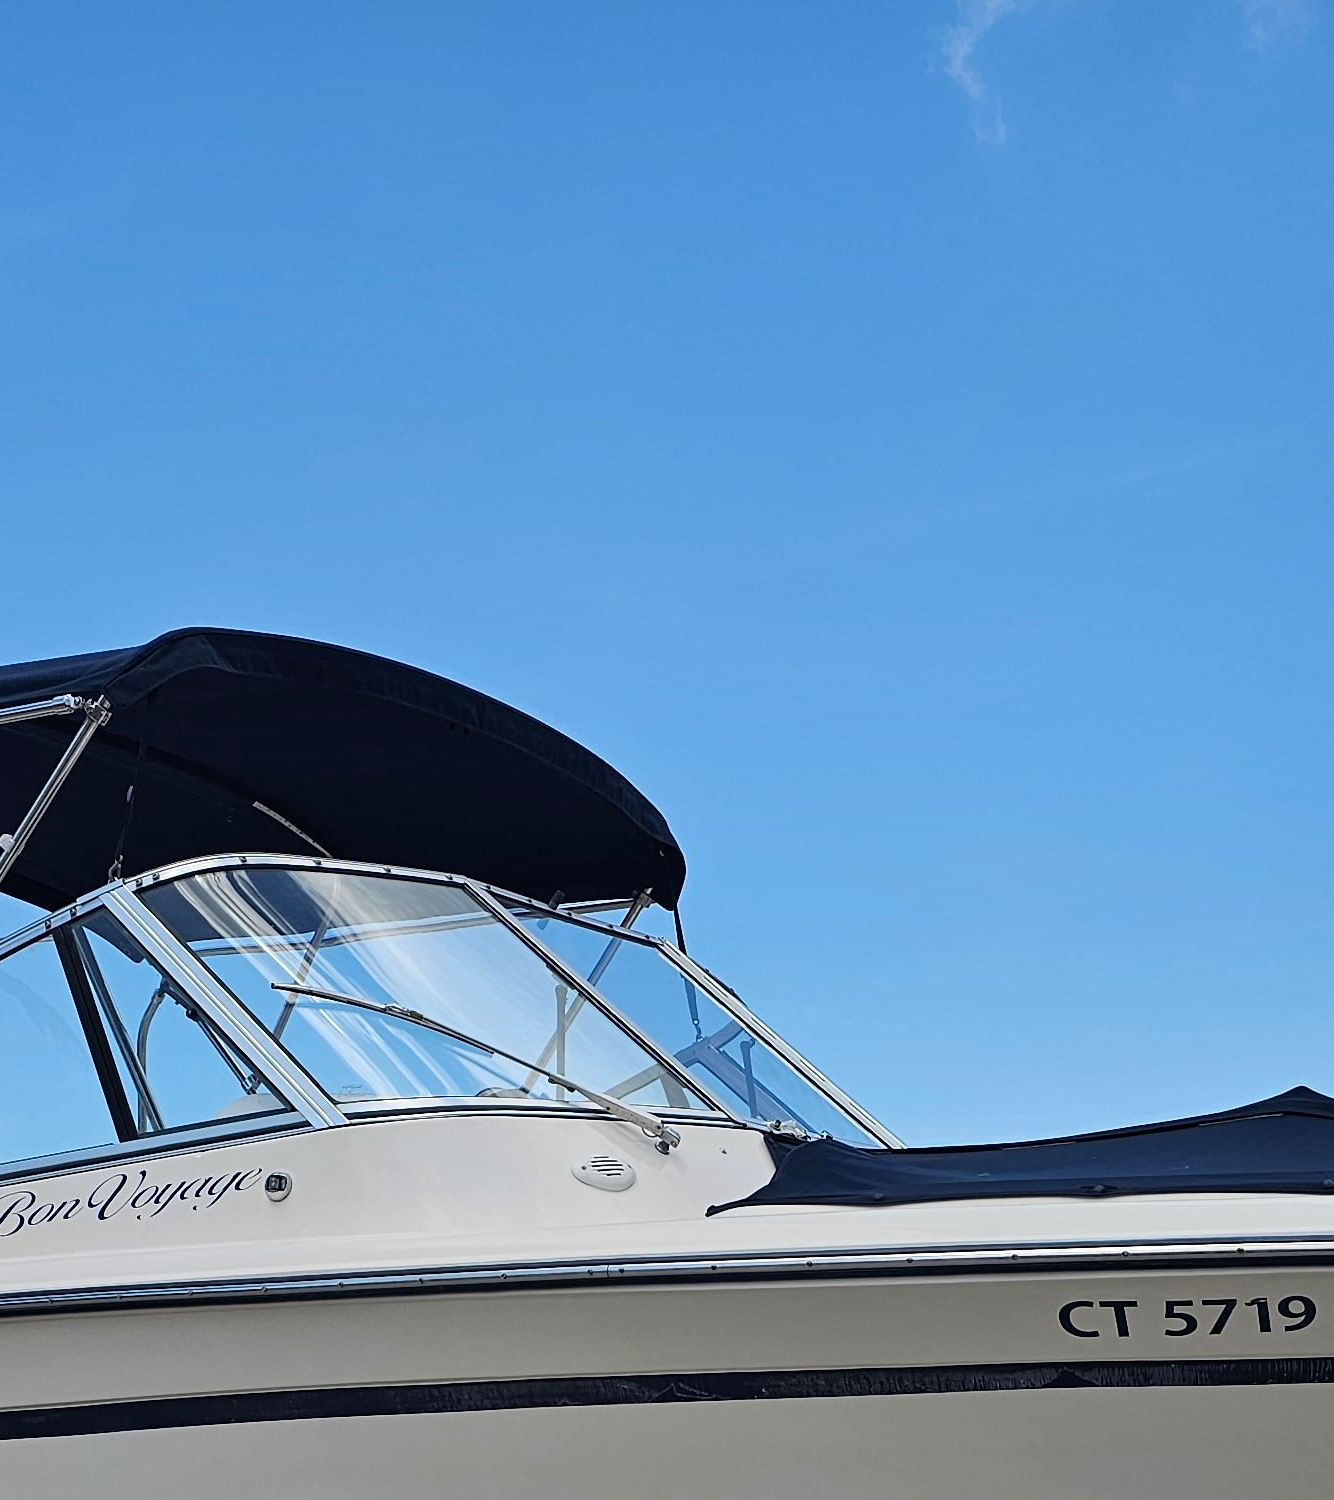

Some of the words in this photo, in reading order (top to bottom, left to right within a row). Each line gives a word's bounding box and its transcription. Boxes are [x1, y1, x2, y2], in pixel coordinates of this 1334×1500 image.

[87, 1168, 263, 1221] Voyage
[1058, 1300, 1138, 1338] CT
[1164, 1295, 1317, 1337] 5719
